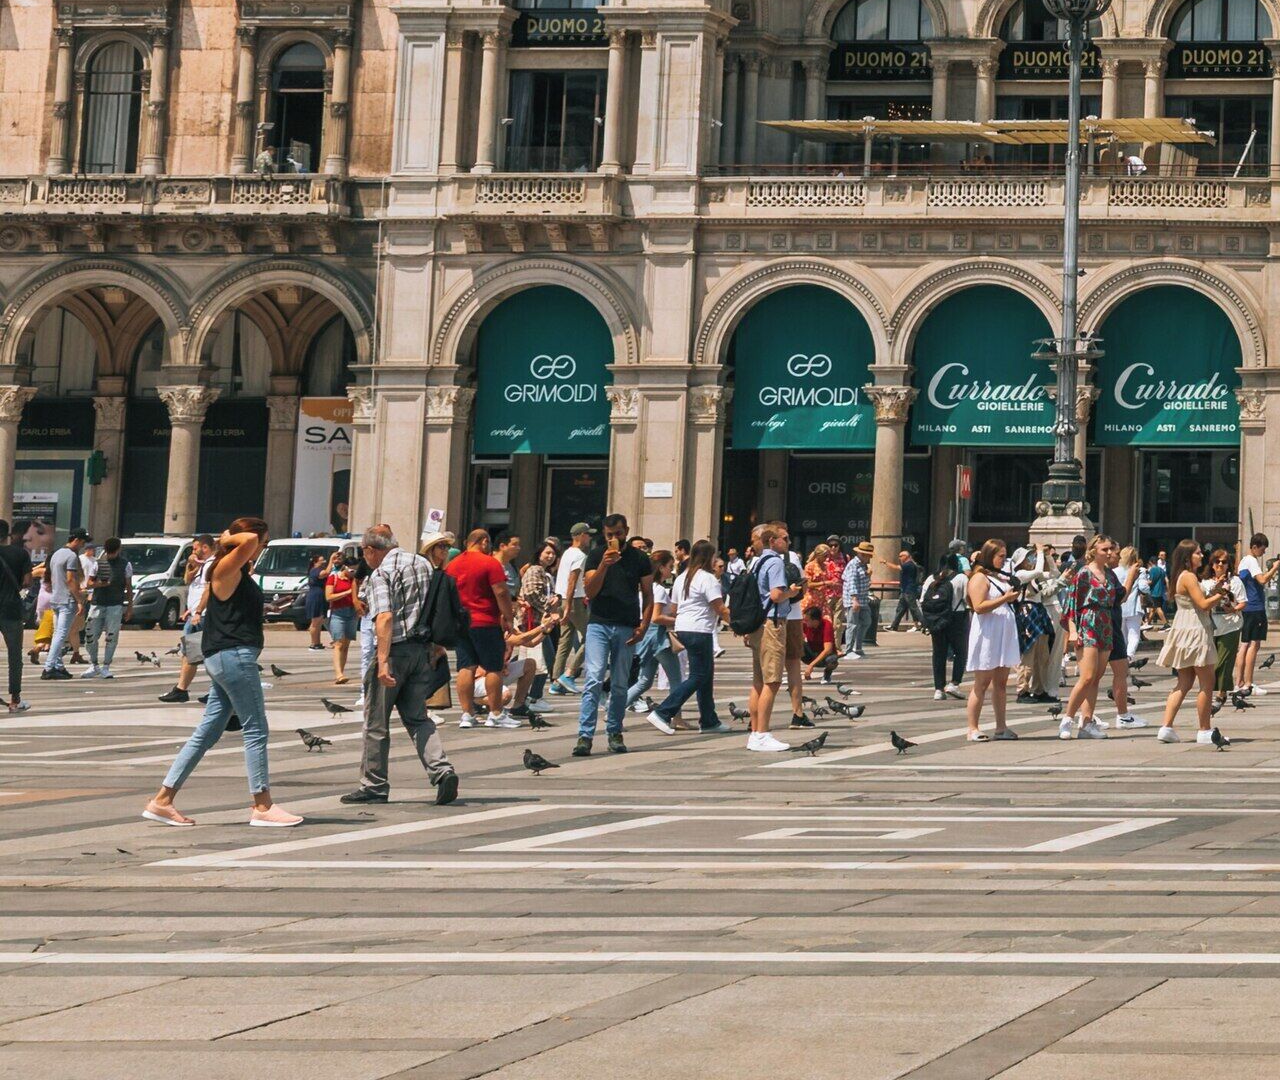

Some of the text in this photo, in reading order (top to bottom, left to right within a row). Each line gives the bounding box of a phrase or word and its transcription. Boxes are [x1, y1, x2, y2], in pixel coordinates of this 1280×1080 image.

[527, 19, 588, 34] DUOMO
[844, 51, 927, 67] DUOMO 21
[1081, 51, 1096, 66] 21
[1182, 49, 1264, 65] DUOMO 21
[504, 384, 597, 402] GRIMOLDI
[927, 362, 1046, 410] Currado
[1114, 362, 1230, 410] Currado
[759, 386, 859, 406] GRIMOLDI
[977, 401, 1045, 411] GIOIELLERIE
[1163, 401, 1228, 410] GIOIELLERIE
[21, 428, 71, 436] CARLO ERBA
[918, 425, 1053, 434] MILANO ASTI SANREMO
[1104, 424, 1236, 432] MILANO ASTI SANREMO
[808, 482, 847, 494] ORIS
